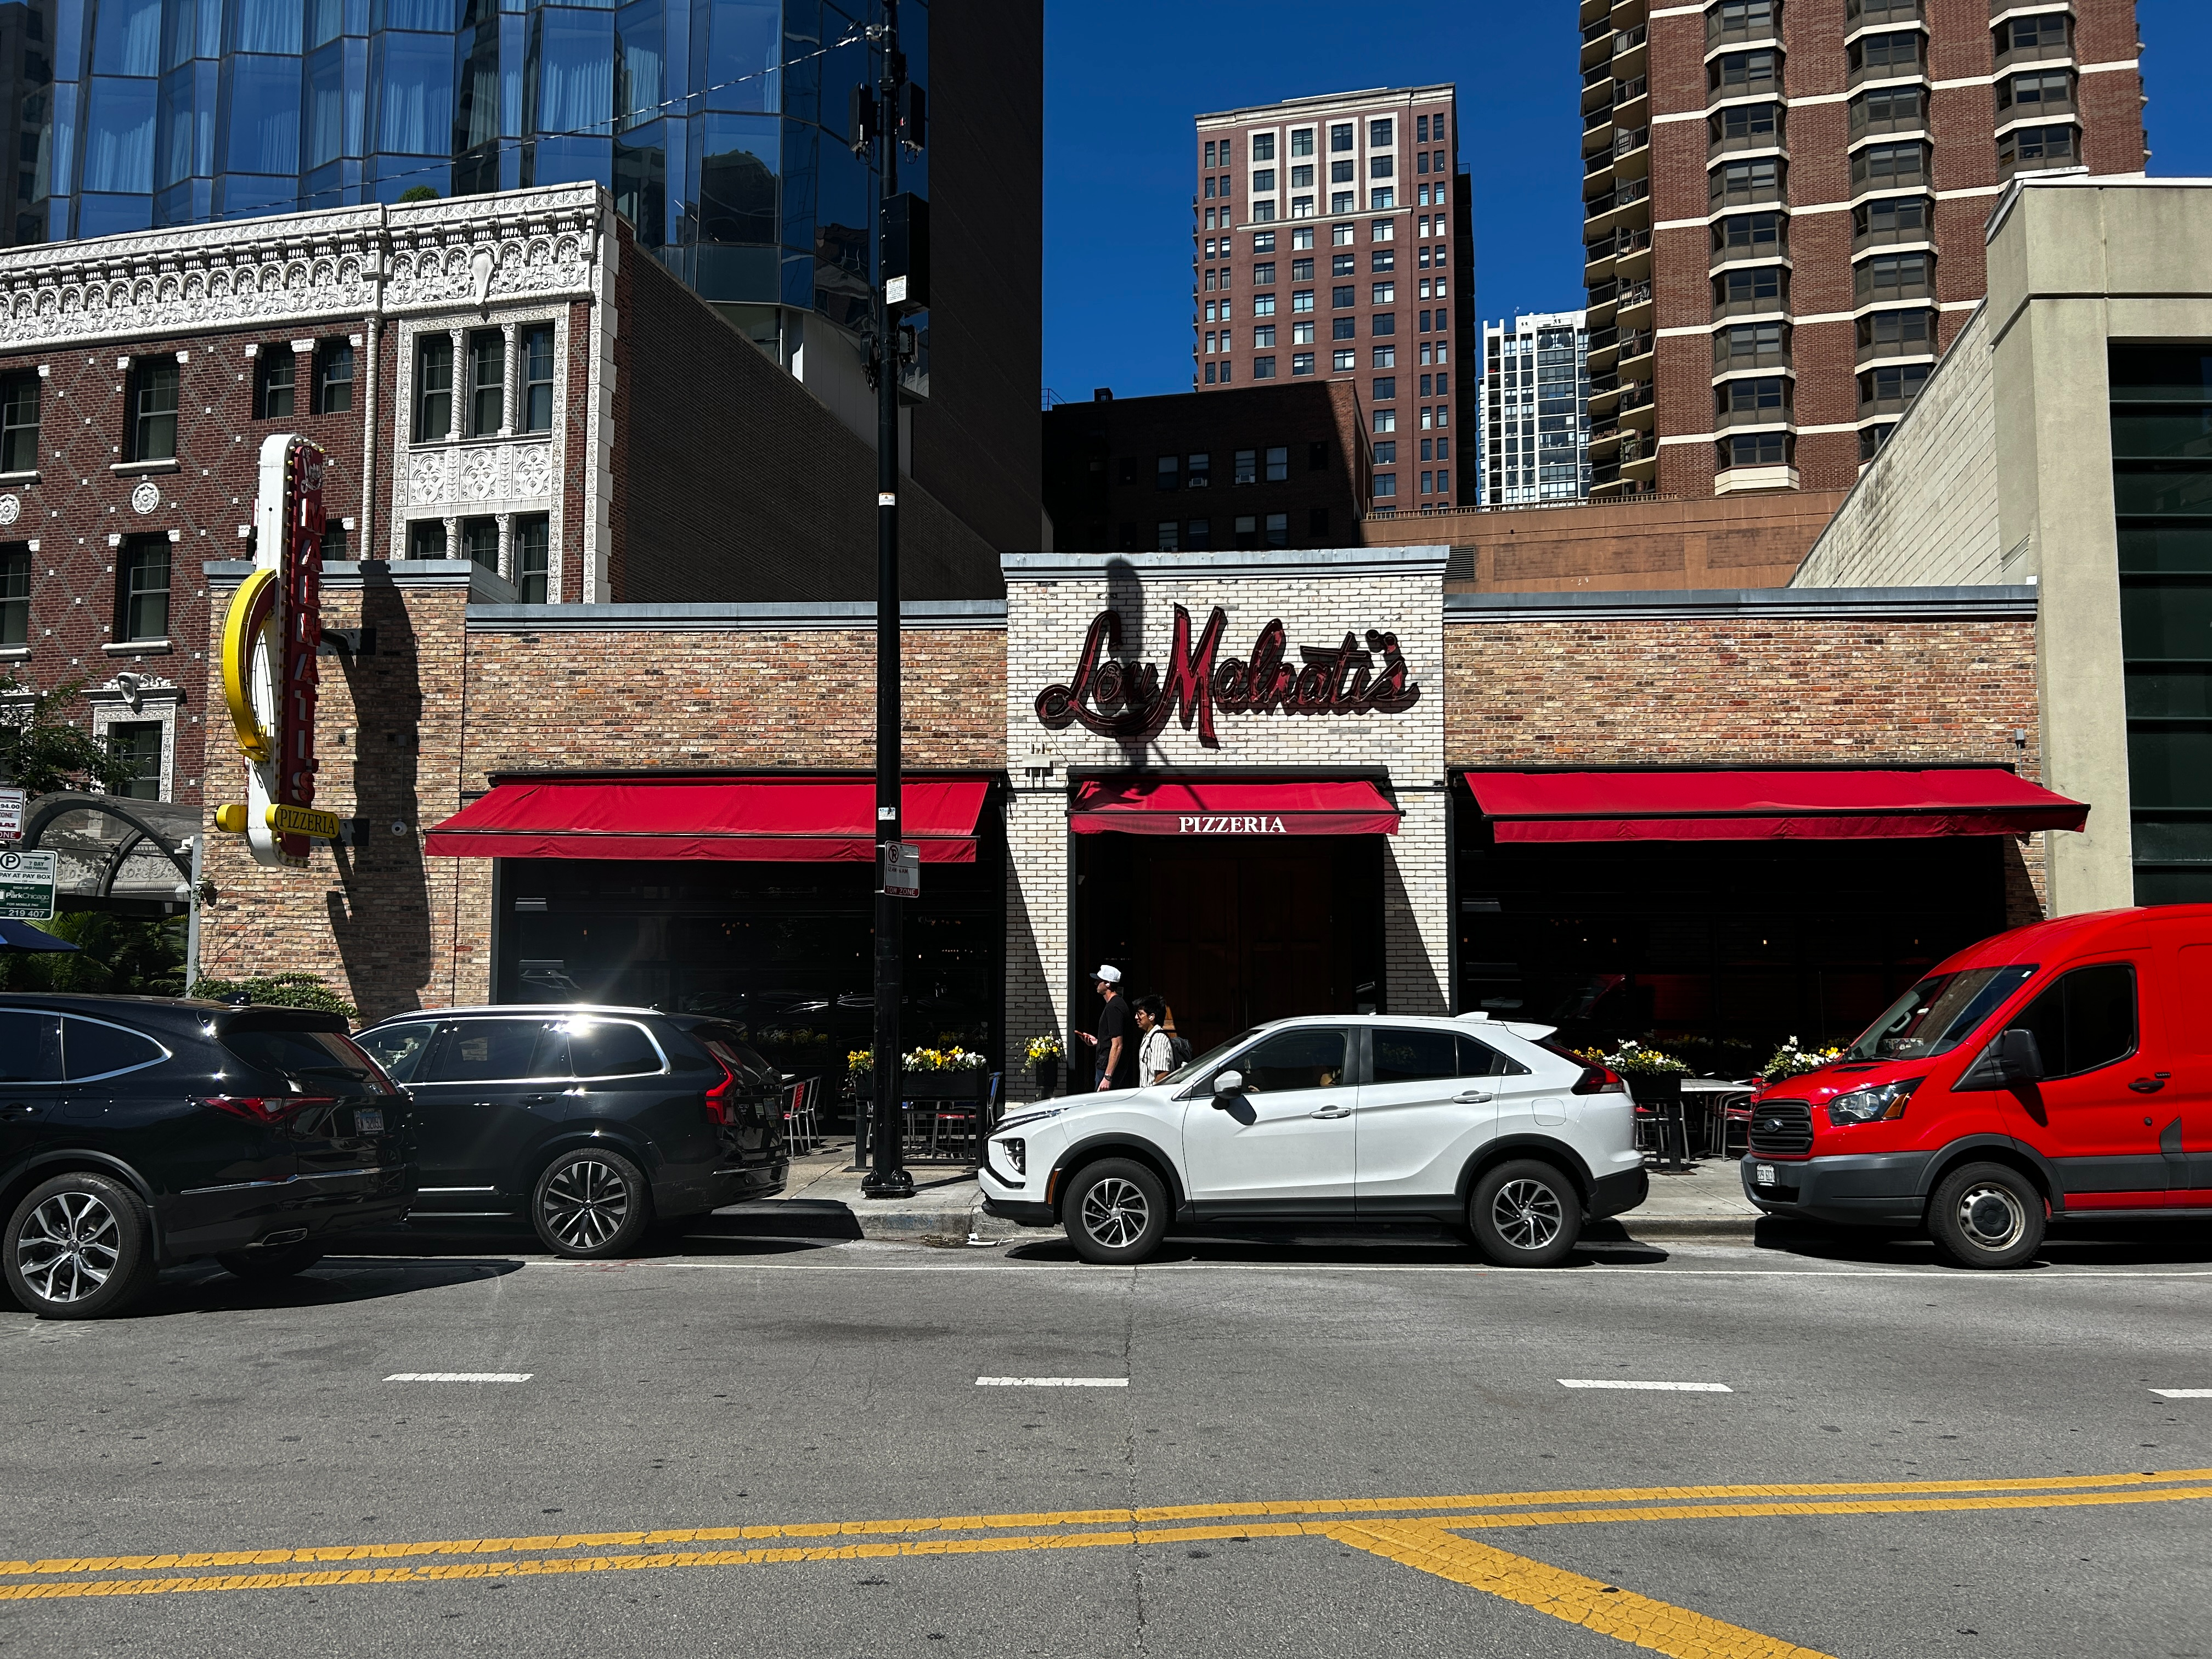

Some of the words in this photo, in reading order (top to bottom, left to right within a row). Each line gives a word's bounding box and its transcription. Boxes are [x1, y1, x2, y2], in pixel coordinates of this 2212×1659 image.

[1035, 609, 1159, 735] Lou
[1147, 602, 1420, 743] Malnati's
[279, 808, 336, 836] PIZZERIA
[1178, 816, 1287, 833] PIZZERIA
[5, 856, 16, 866] P
[5, 892, 50, 900] ParkChicago
[899, 888, 916, 896] ZONE
